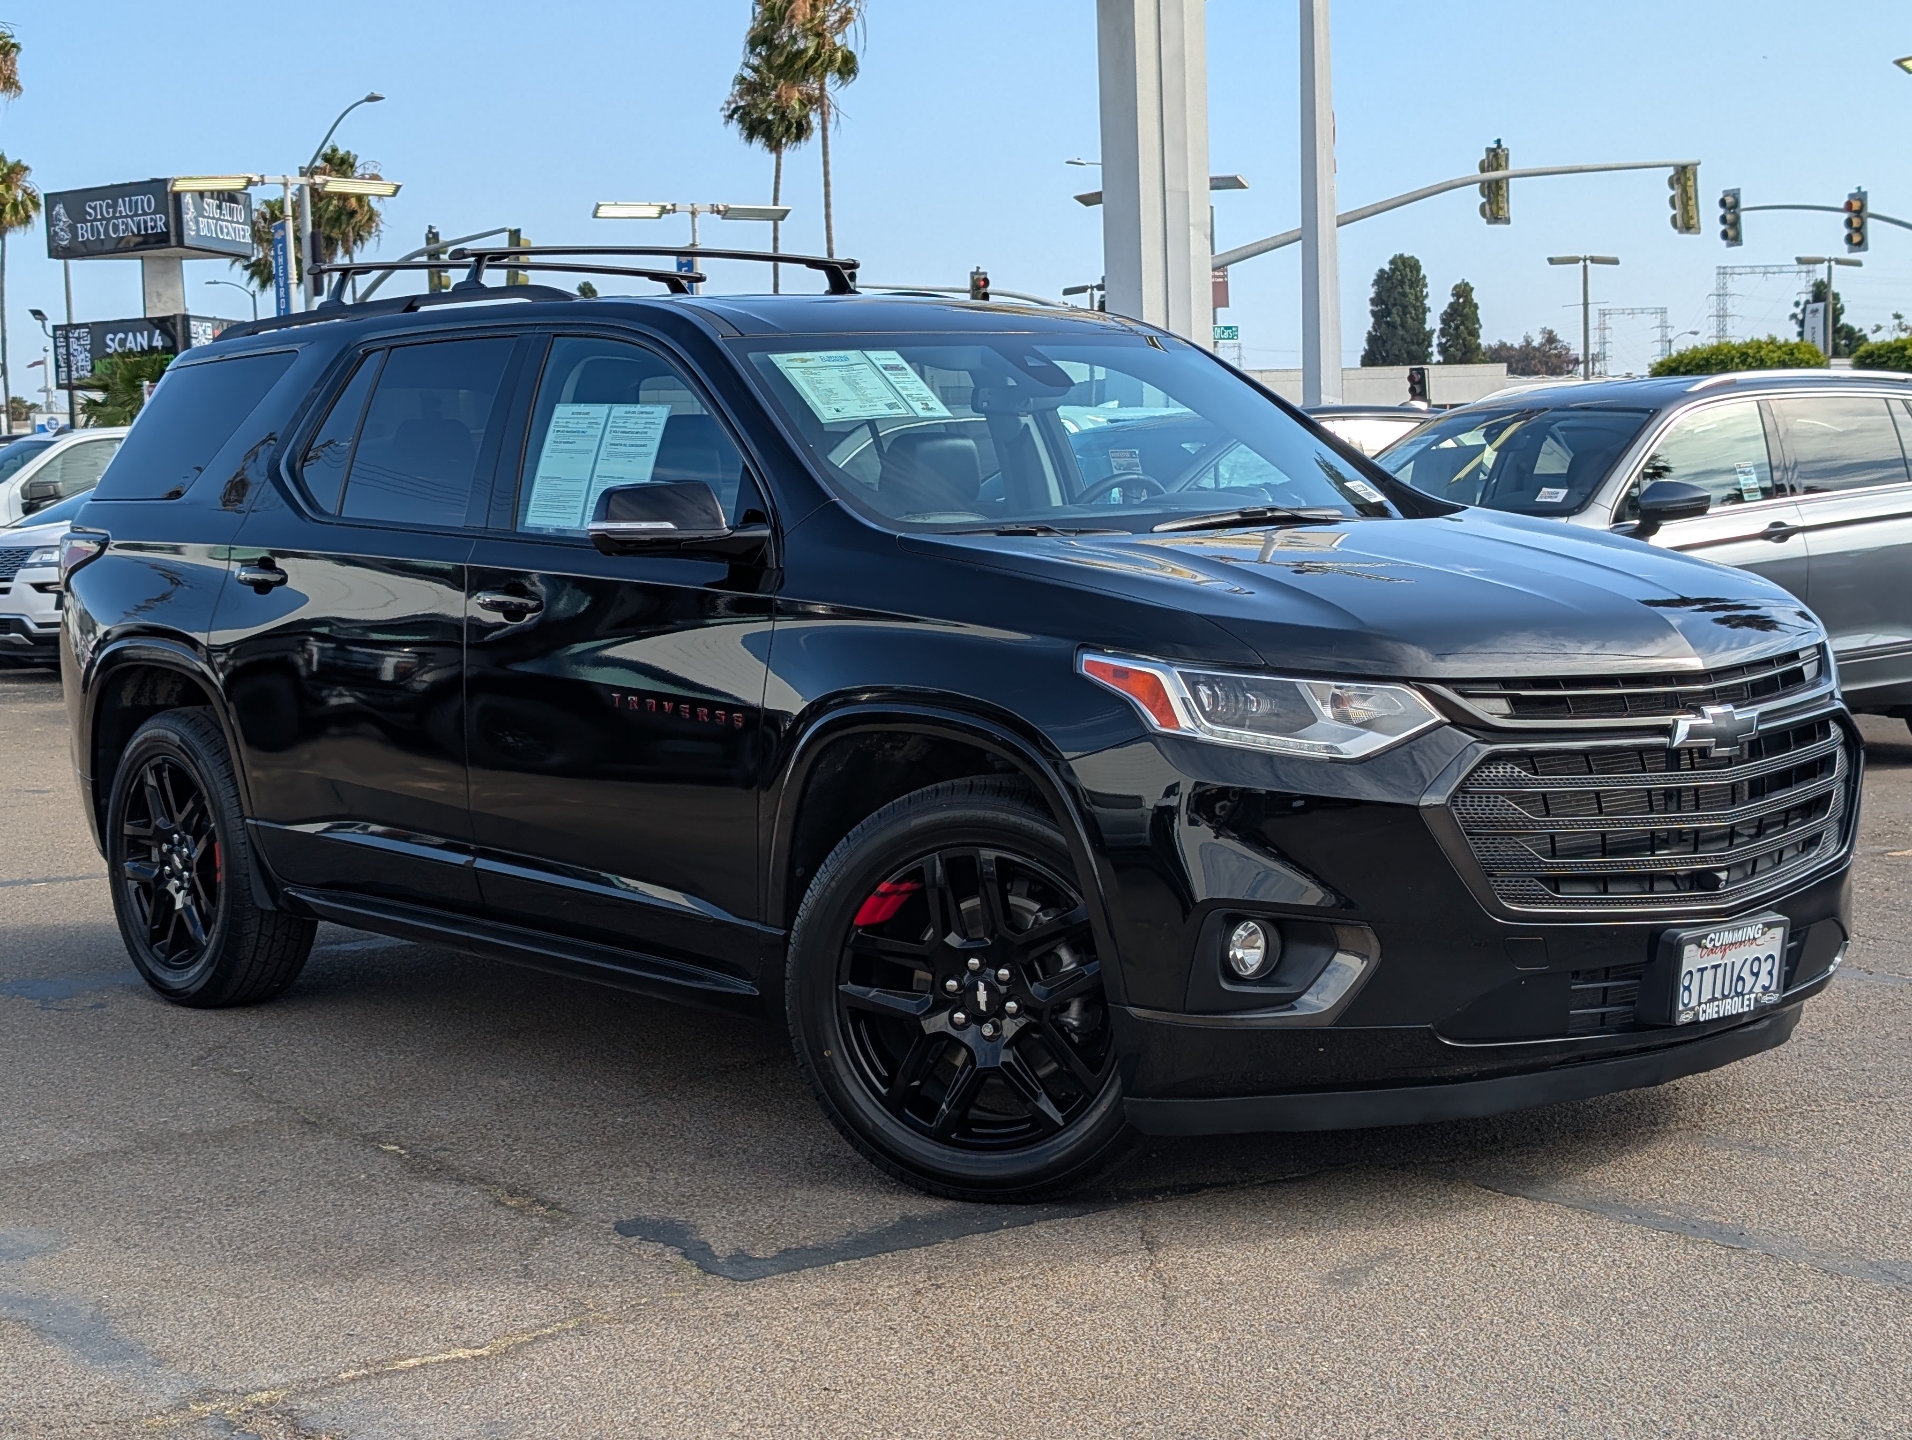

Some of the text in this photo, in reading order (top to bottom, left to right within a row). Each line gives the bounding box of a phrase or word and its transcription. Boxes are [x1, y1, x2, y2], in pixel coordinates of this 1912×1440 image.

[85, 194, 155, 220] STG AUTO
[203, 198, 245, 223] STG AUTO
[77, 214, 167, 242] BUY CENTER
[198, 217, 252, 244] BUY CENTER
[105, 329, 164, 354] SCAN 4
[1221, 327, 1233, 339] Cars
[611, 693, 745, 729] TRAVERSE
[1706, 923, 1763, 948] CUMMING
[1681, 953, 1776, 1008] 8TIU693
[1698, 993, 1756, 1022] CHEVROLET
